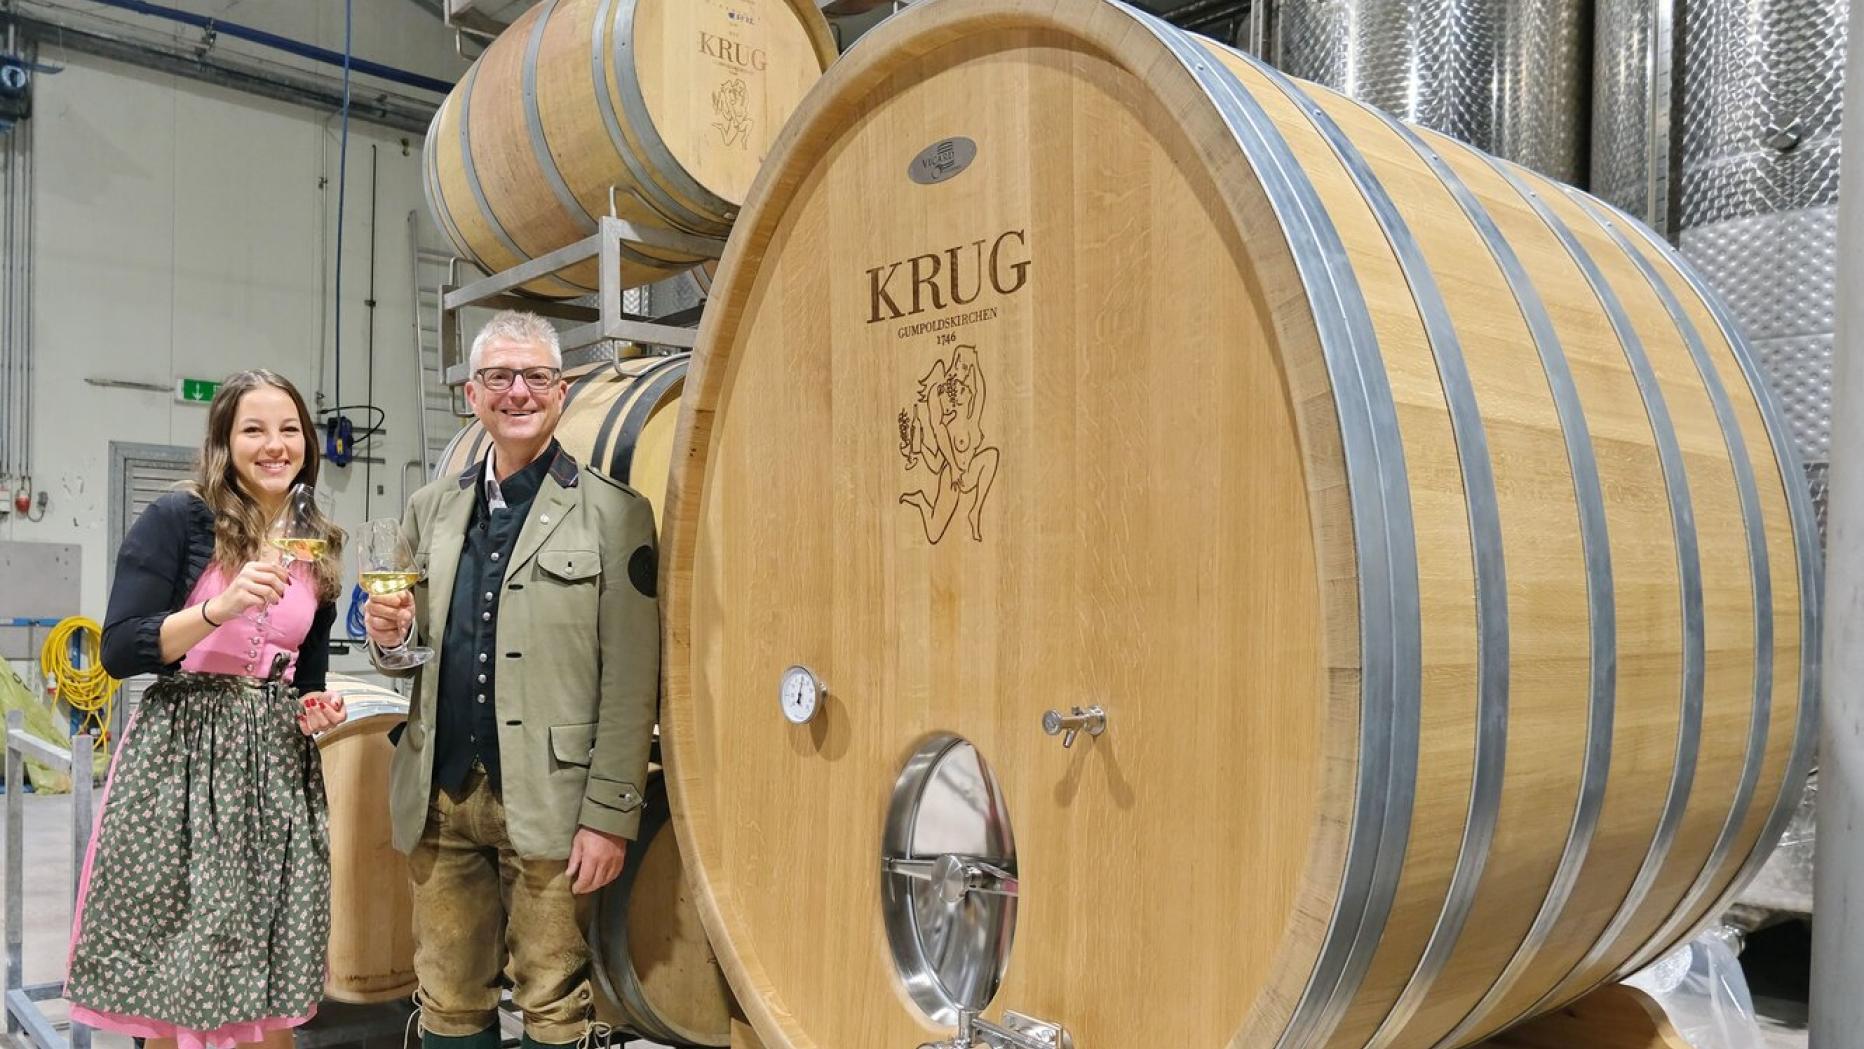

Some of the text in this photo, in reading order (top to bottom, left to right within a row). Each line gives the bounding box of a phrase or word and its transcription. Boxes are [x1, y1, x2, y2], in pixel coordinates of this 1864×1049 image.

[699, 31, 767, 71] KRUG
[865, 229, 1031, 324] KRUG
[897, 307, 998, 339] GUMPOLDSKIRCHEN
[936, 331, 957, 346] 1746
